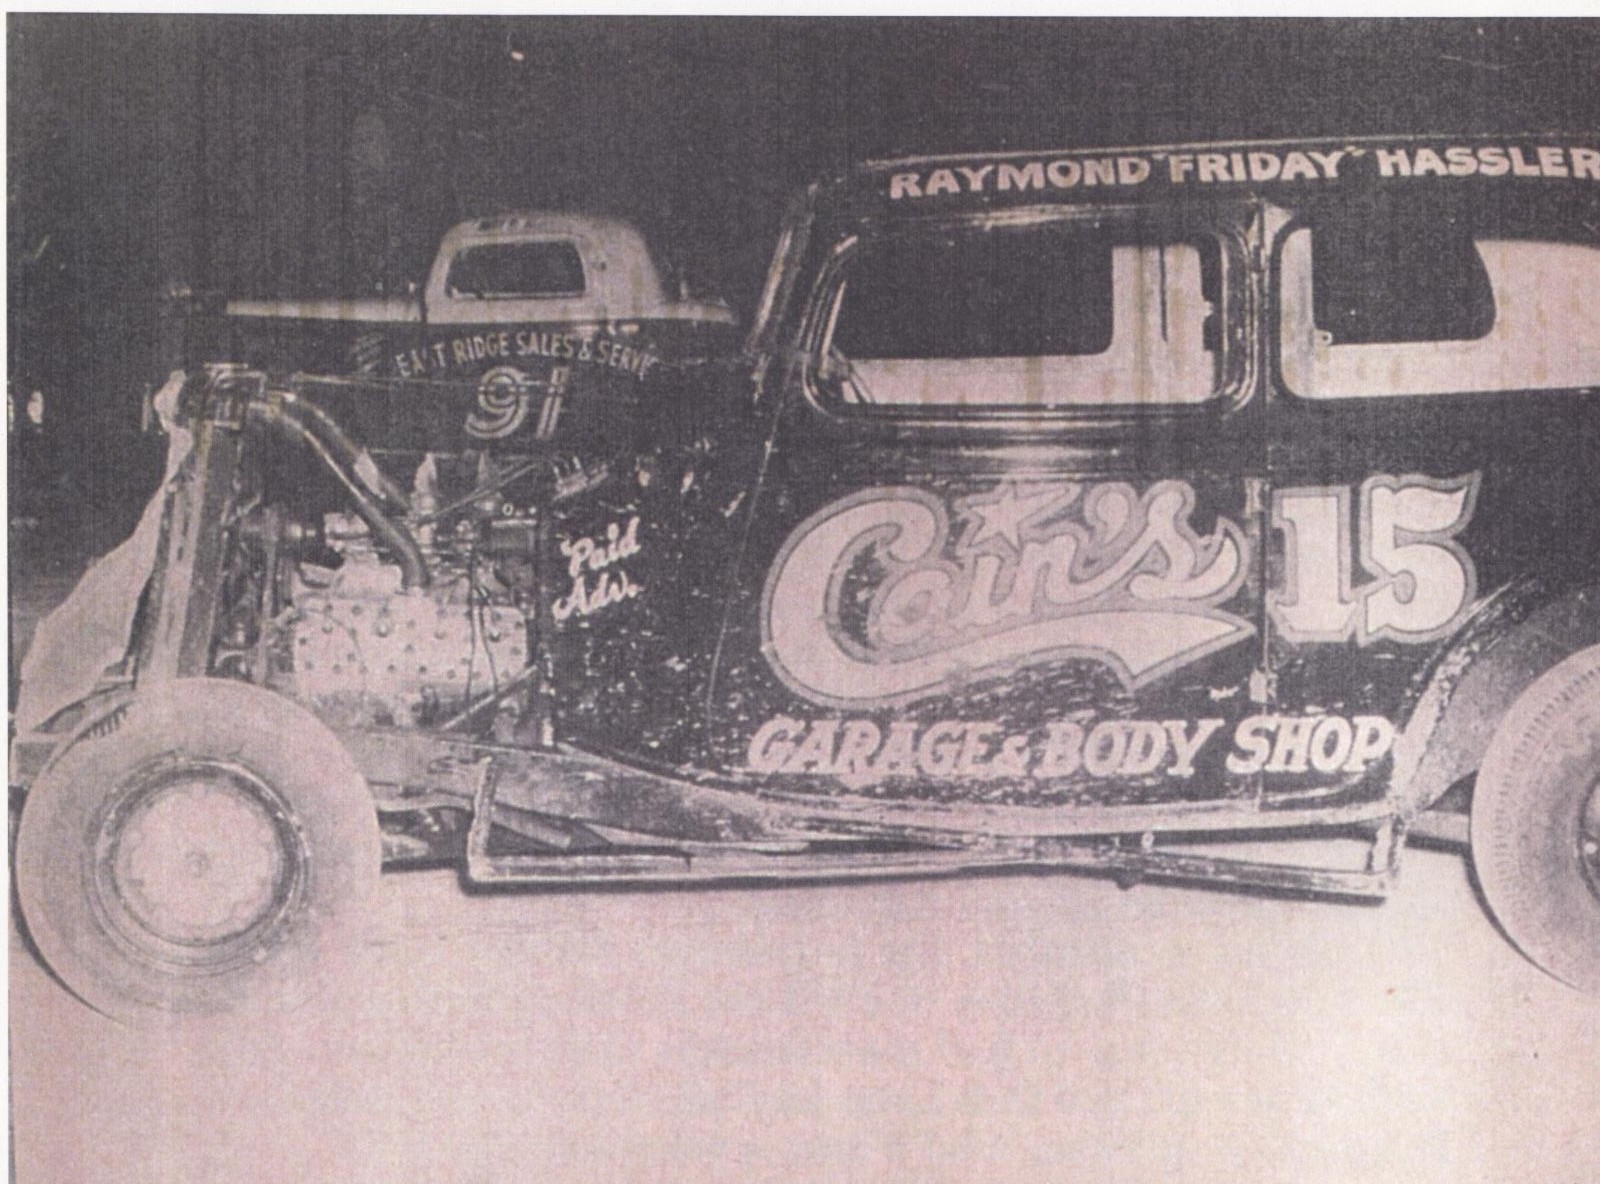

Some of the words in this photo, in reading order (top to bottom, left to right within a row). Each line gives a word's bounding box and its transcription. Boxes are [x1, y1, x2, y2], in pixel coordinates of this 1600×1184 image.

[890, 156, 1151, 200] RAYMOND
[1375, 145, 1600, 181] HASSLER
[452, 333, 510, 365] RIDGE
[515, 332, 574, 358] SALES
[578, 336, 592, 360] &
[463, 364, 569, 439] 91
[560, 516, 642, 578] Paid
[1264, 470, 1482, 648] 15
[748, 716, 1002, 788] GARAGE
[991, 734, 1030, 778] &
[1032, 718, 1225, 778] BODY
[1225, 713, 1395, 775] SHOP
